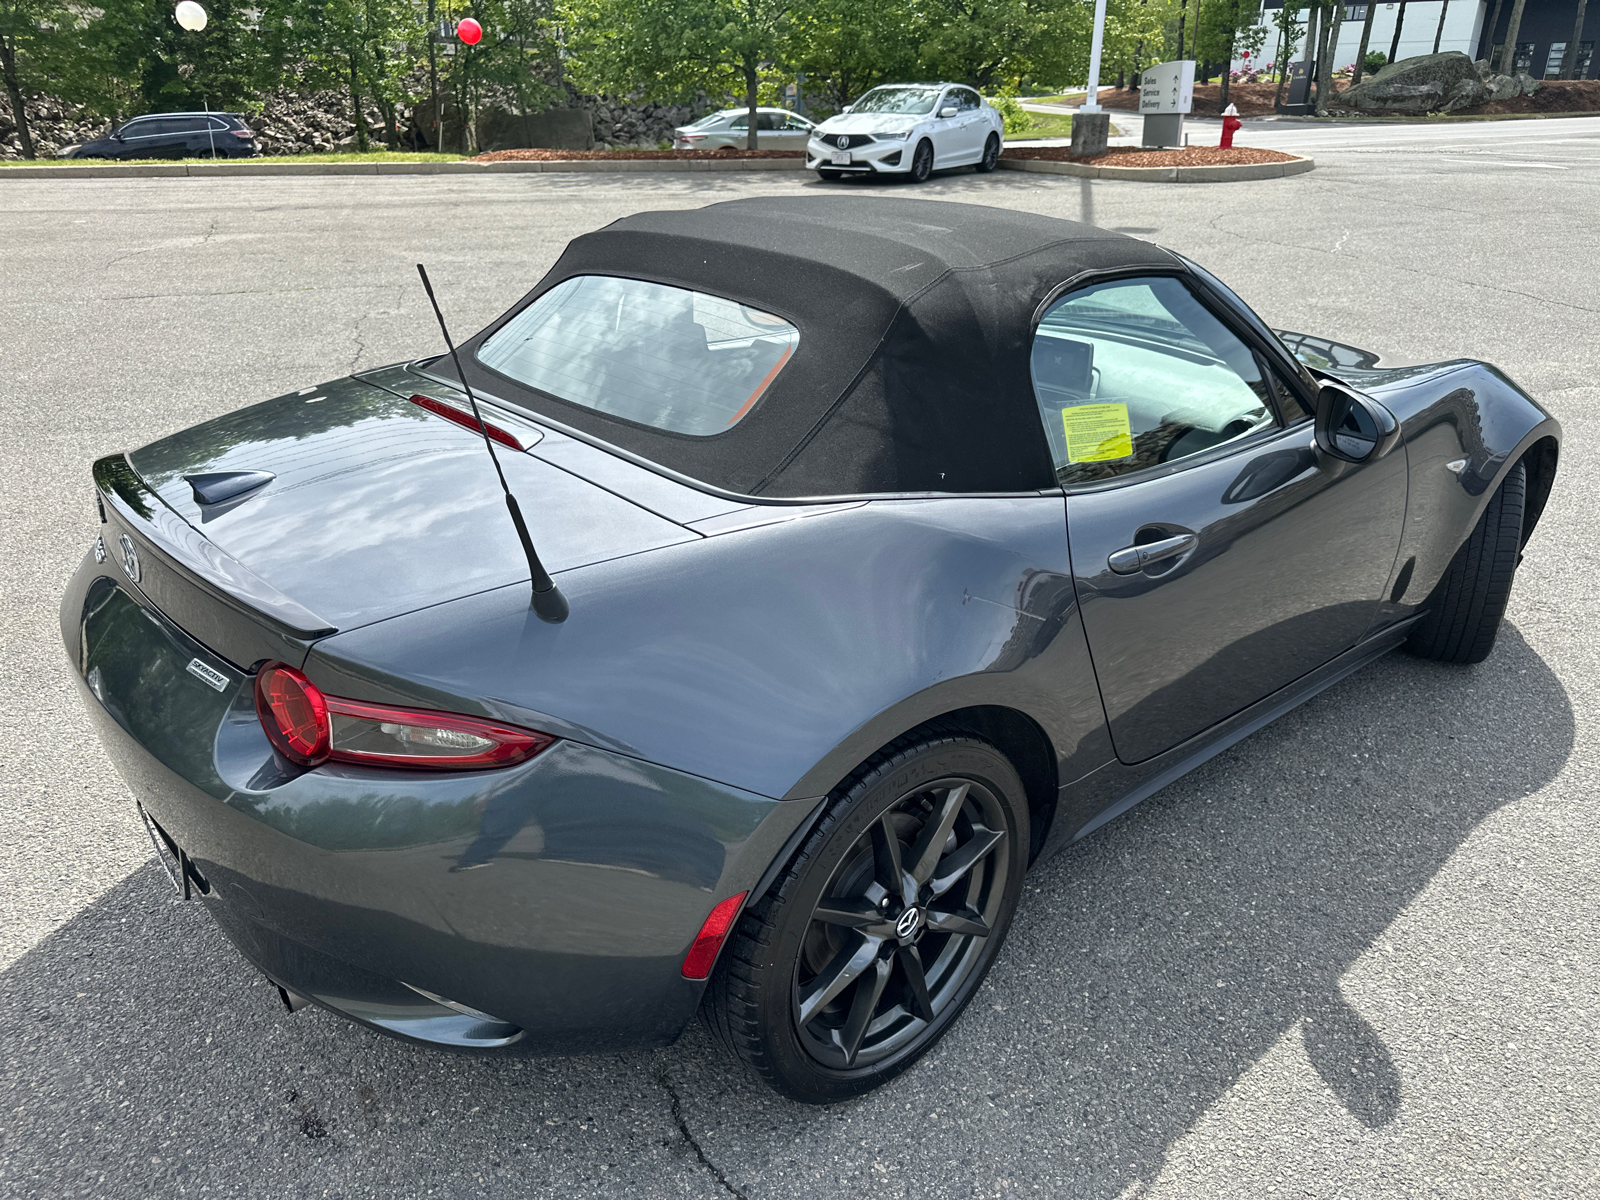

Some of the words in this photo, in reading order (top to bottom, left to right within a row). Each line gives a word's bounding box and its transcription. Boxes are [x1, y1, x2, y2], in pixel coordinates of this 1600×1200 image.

[1144, 77, 1157, 85] Sales
[1143, 88, 1160, 97] Service
[1142, 100, 1160, 109] Delivery
[192, 660, 223, 682] SKYACTIV
